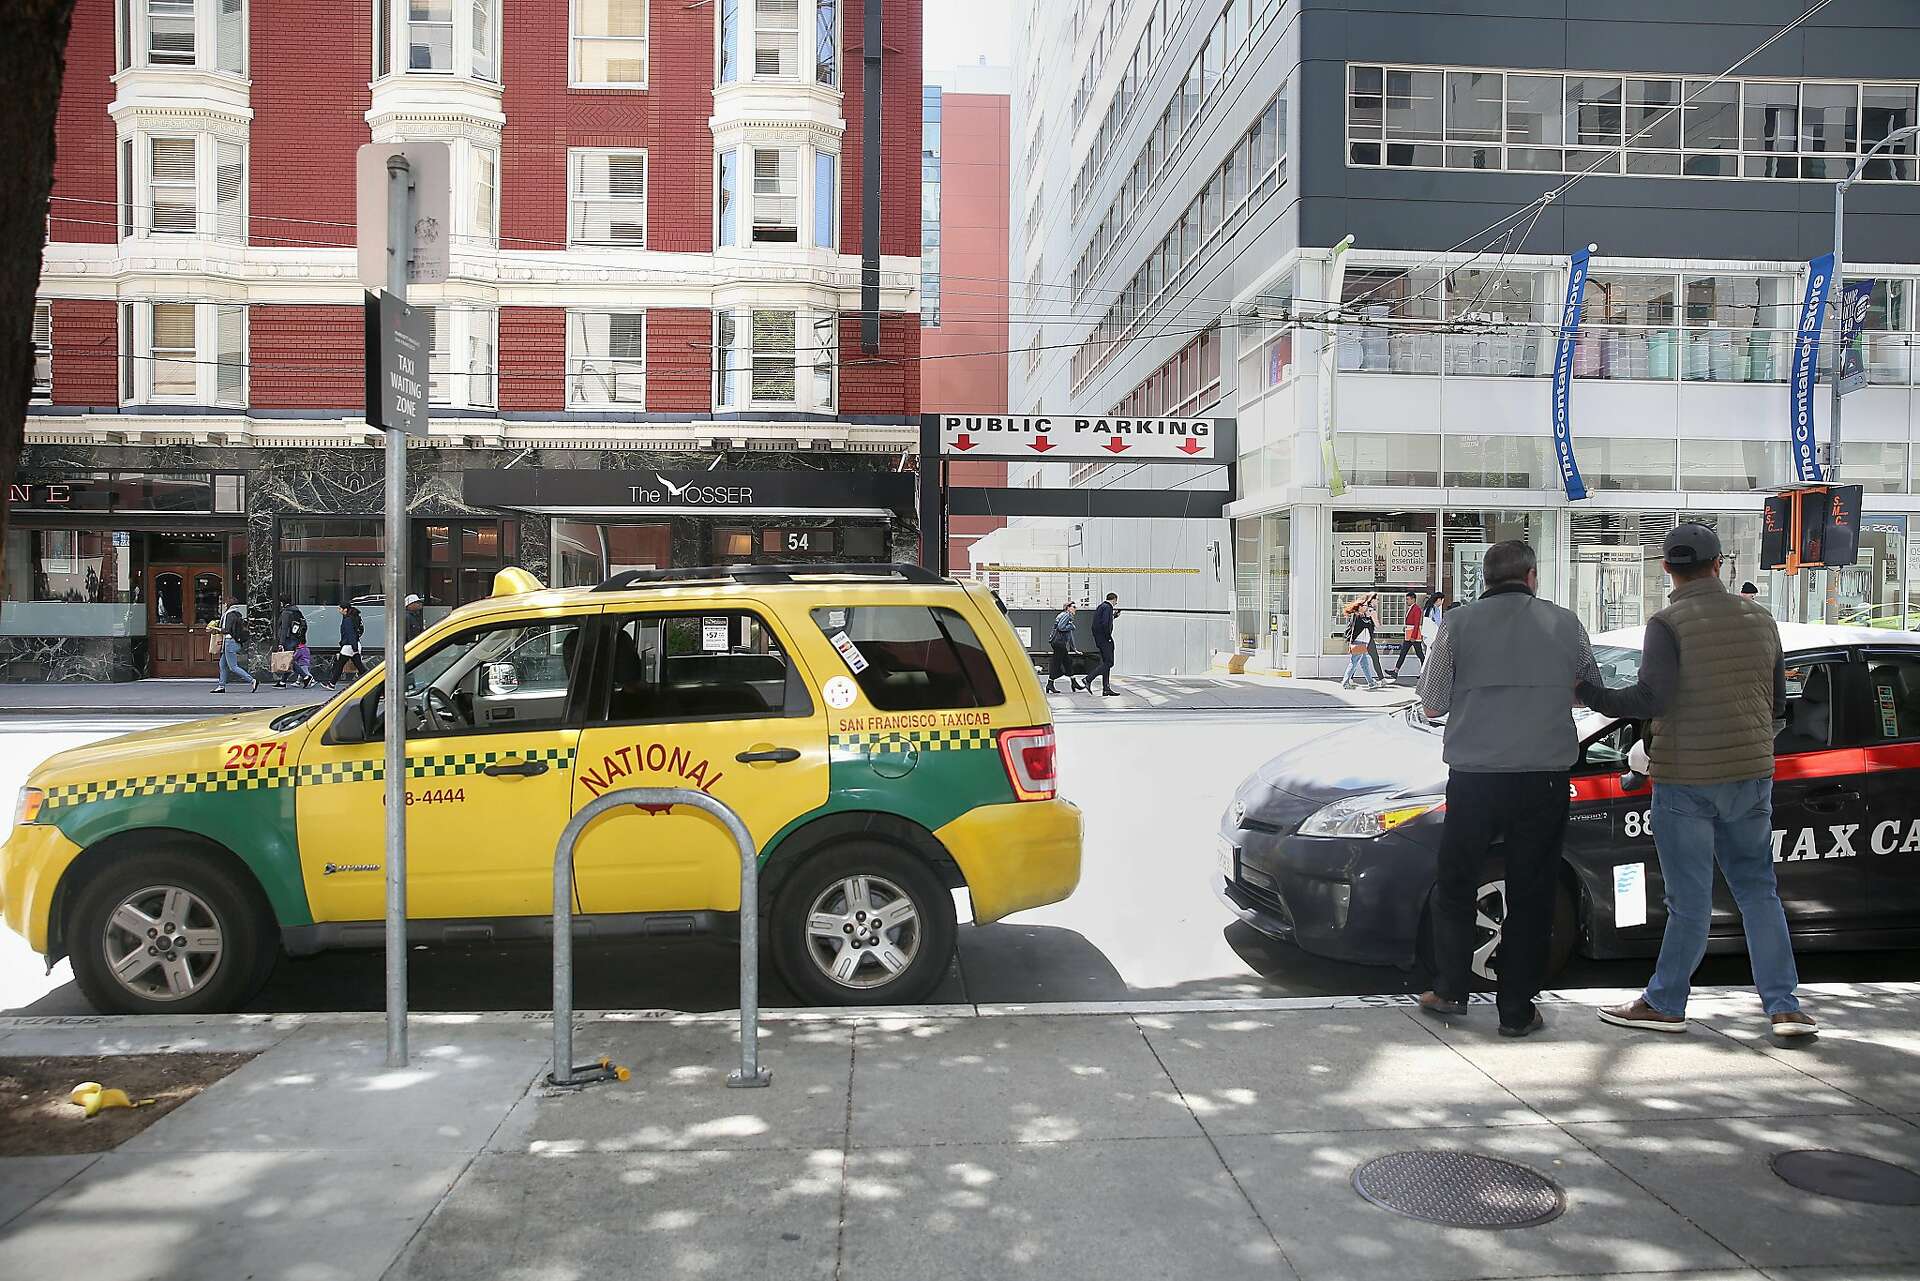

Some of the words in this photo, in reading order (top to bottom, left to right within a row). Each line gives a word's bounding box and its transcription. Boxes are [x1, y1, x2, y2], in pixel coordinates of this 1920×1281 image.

[1802, 274, 1825, 333] Store
[398, 354, 415, 376] TAXI
[1556, 331, 1572, 439] Container
[1564, 269, 1582, 327] Store
[390, 371, 422, 399] WAITING
[1796, 336, 1813, 441] Container
[396, 395, 416, 417] ZONE
[946, 417, 1052, 432] PUBLIC
[1074, 419, 1209, 436] PARKING
[628, 486, 661, 503] The
[660, 478, 754, 504] MOSSER
[788, 533, 809, 550] 54
[1340, 547, 1373, 558] closet
[1391, 547, 1424, 558] closet
[839, 718, 864, 732] SAN
[868, 713, 937, 730] FRANCISCO
[941, 712, 991, 727] TAXICAB
[224, 742, 288, 769] 2971
[579, 743, 723, 797] NATIONAL
